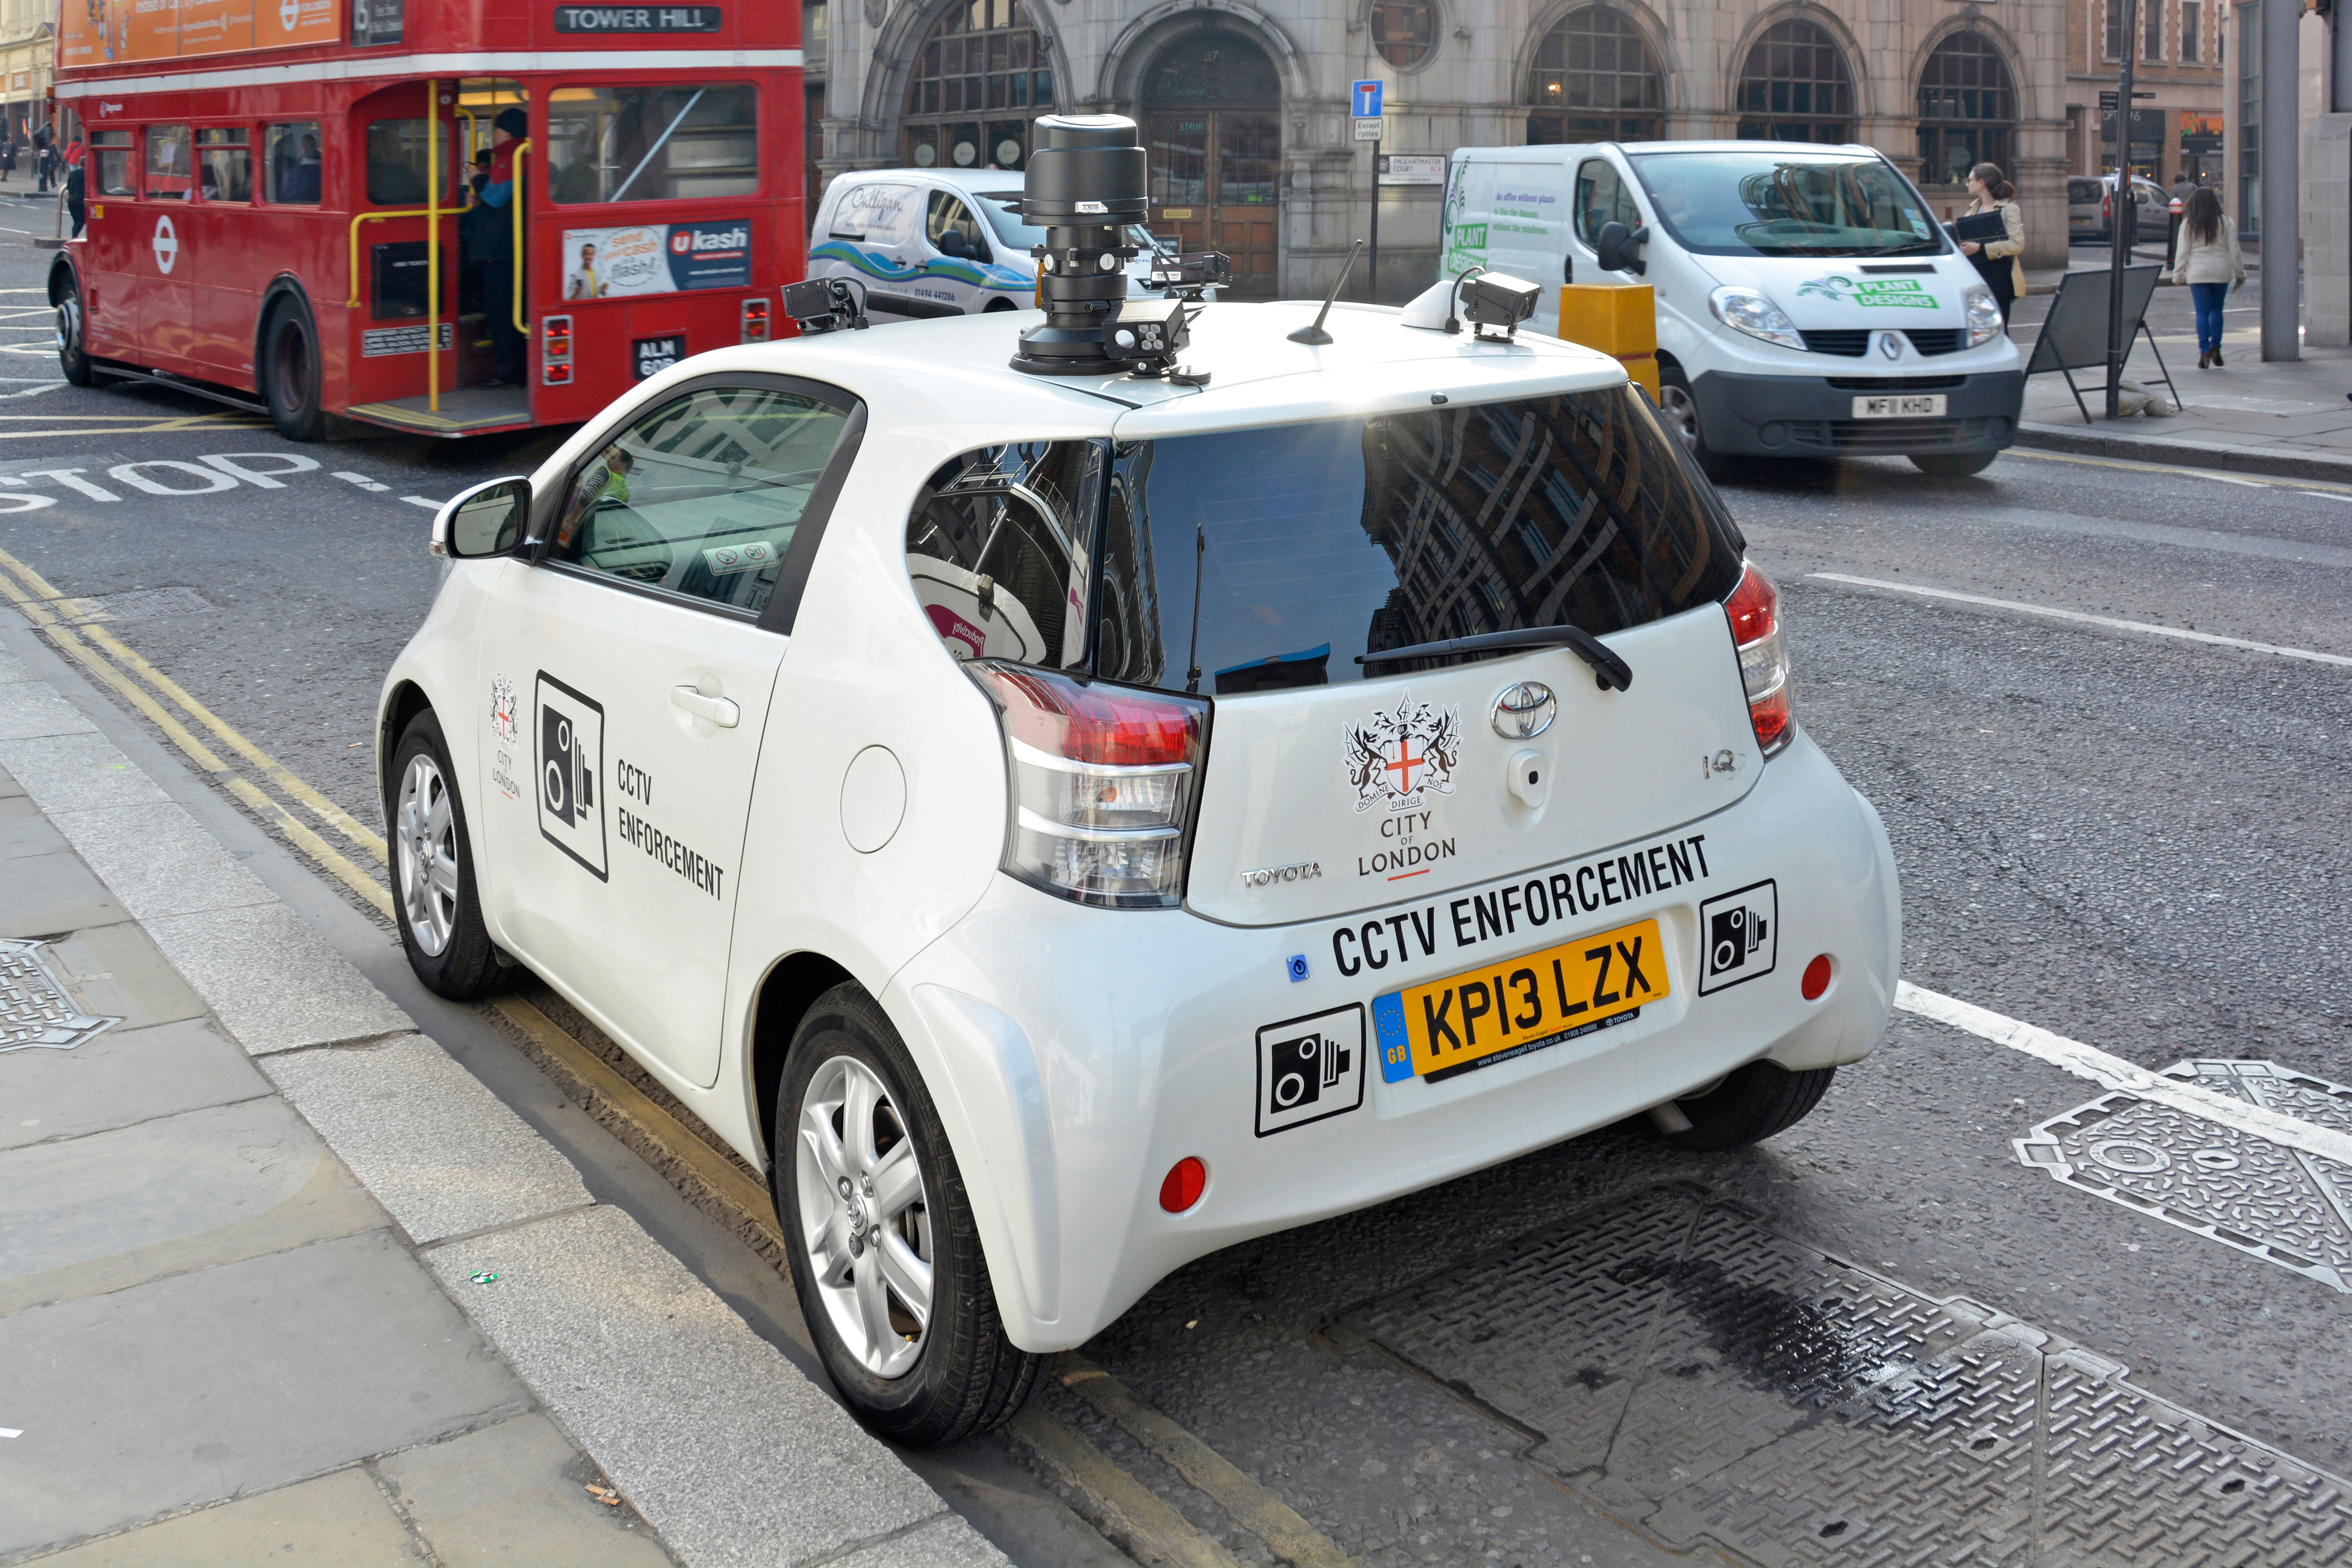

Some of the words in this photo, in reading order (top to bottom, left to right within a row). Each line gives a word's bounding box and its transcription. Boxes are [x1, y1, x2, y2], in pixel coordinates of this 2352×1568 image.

[564, 9, 651, 28] TOWER
[659, 9, 705, 27] HILL
[2102, 110, 2140, 122] OPTNS
[852, 188, 903, 221] Culligan
[1503, 193, 1517, 201] office
[1518, 194, 1537, 202] without
[1538, 194, 1555, 205] plants
[612, 229, 645, 247] send
[1457, 227, 1485, 247] PLANT
[915, 289, 931, 298] 01494
[934, 290, 955, 301] 441286
[1862, 281, 1915, 292] PLANT
[1861, 295, 1933, 307] DESIGNS
[639, 340, 676, 358] ALM
[1902, 397, 1933, 414] KHD
[498, 750, 511, 770] CITY
[493, 767, 520, 799] LONDON
[618, 759, 652, 806] CCTV
[1357, 784, 1390, 809] DOMINE
[1391, 796, 1422, 809] DIRIGE
[1426, 777, 1444, 790] NOS
[1380, 811, 1432, 838] CITY
[1401, 835, 1414, 846] OF
[619, 806, 723, 902] ENFORCEMENT
[1358, 837, 1456, 877] LONDON
[1240, 861, 1323, 888] TOYOTA
[1334, 907, 1435, 976] CCTV
[1455, 834, 1709, 946] ENFORCEMENT
[1423, 967, 1542, 1056] KP13
[1552, 936, 1651, 1018] LZX
[1477, 1035, 1561, 1067] www.steveneagell.toyota.co.uk
[1564, 1029, 1579, 1040] 01908
[1580, 1024, 1597, 1035] 248888
[1613, 1012, 1634, 1024] TOYOTA
[1387, 1047, 1406, 1065] GB
